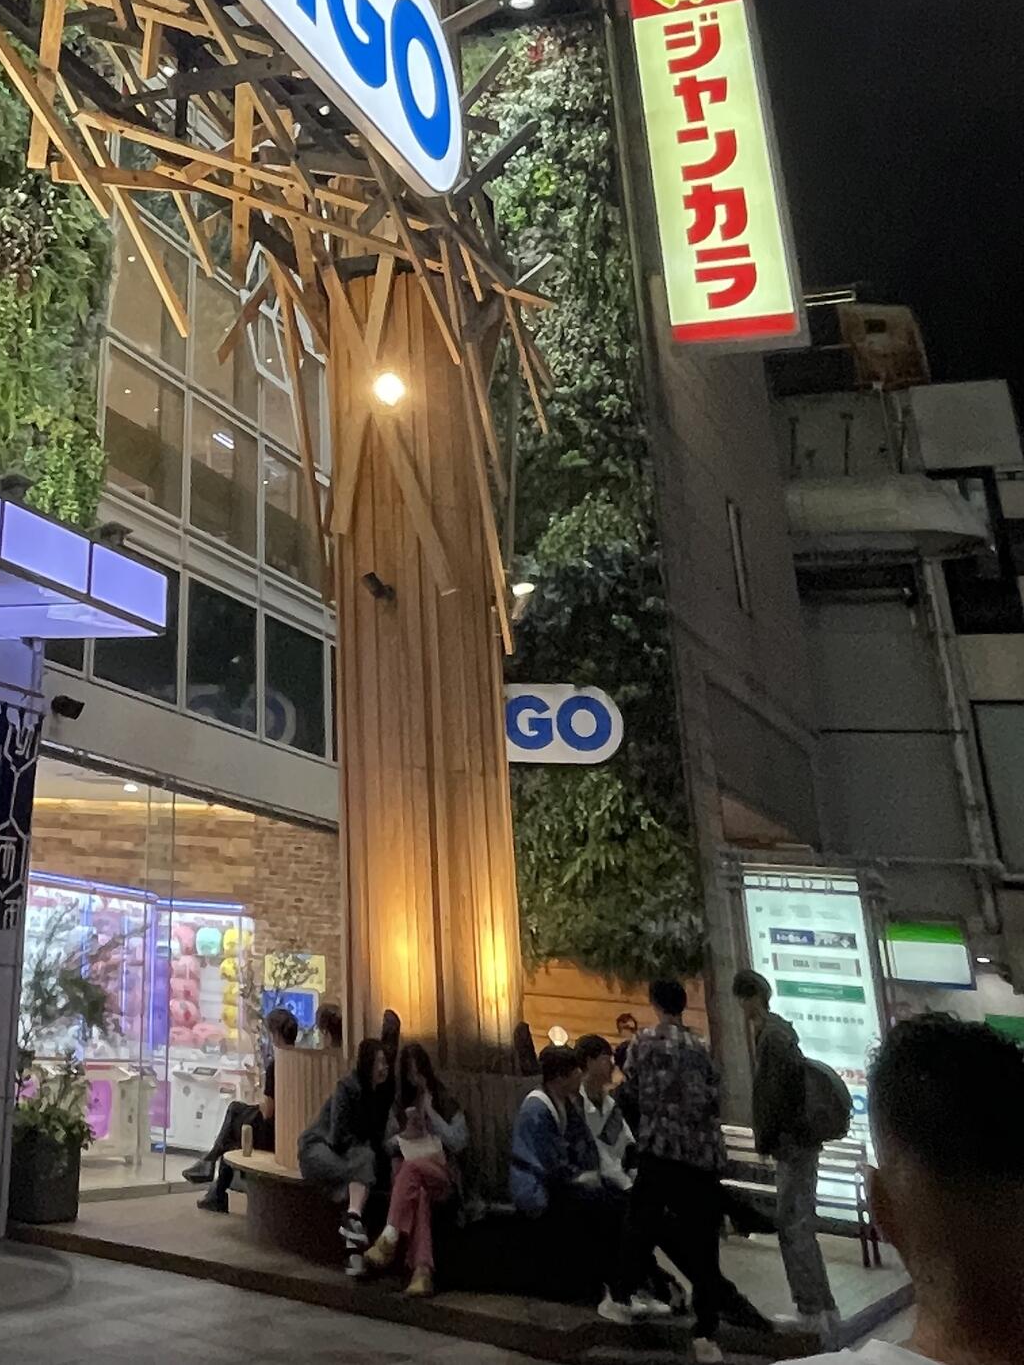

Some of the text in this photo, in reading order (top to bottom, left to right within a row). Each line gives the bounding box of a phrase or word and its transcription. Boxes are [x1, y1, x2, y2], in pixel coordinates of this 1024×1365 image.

[663, 11, 758, 311] ジャンカラ
